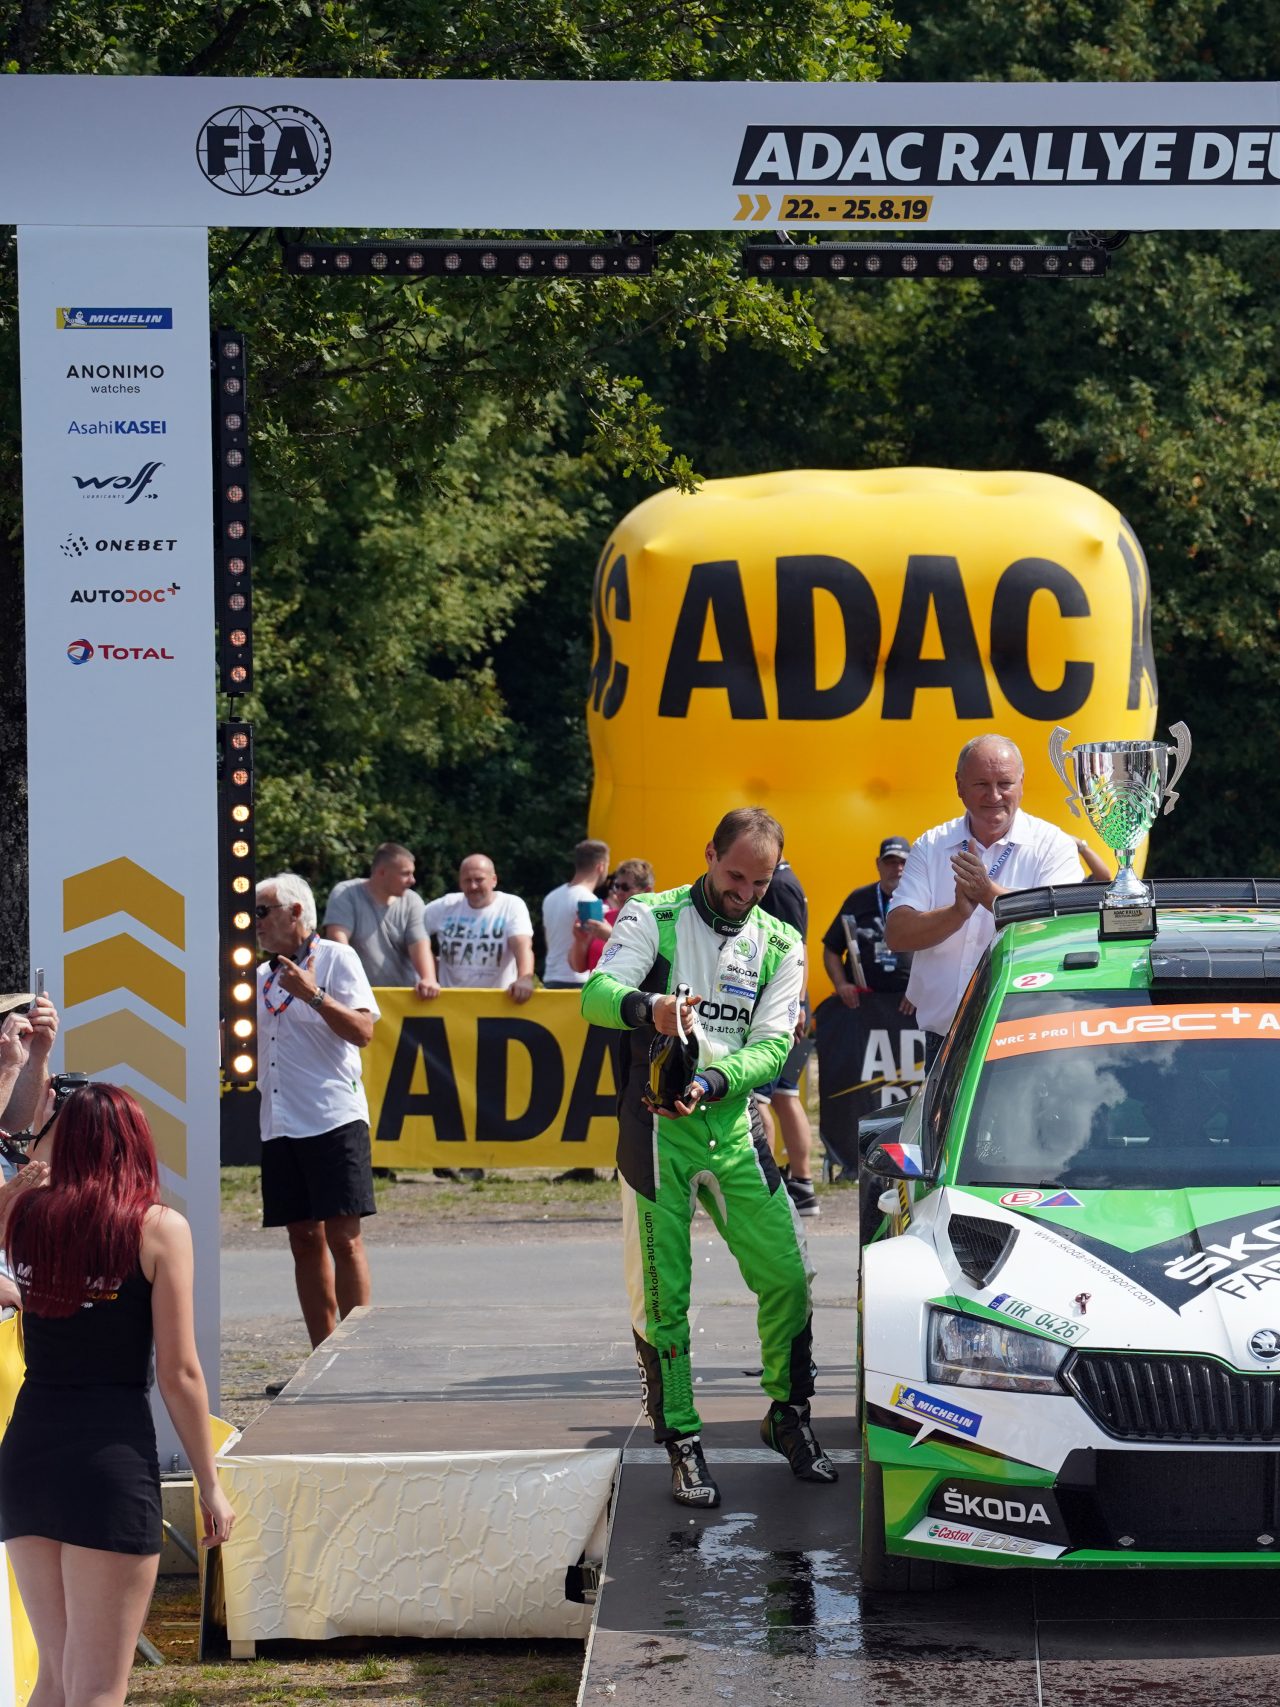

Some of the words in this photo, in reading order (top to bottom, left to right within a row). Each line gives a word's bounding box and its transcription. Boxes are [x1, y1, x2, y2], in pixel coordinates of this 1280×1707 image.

[744, 131, 925, 182] ADAC
[937, 131, 1178, 182] RALLYE
[785, 199, 820, 219] 22.
[842, 199, 928, 220] 25.8.19
[88, 314, 163, 323] MICHELIN
[66, 364, 165, 379] ANONIMO
[91, 384, 141, 394] watches
[95, 539, 178, 551] ONEBET
[70, 589, 166, 603] AUTODOC
[658, 554, 1096, 721] ADAC
[769, 936, 790, 951] OMP
[699, 1000, 751, 1025] ODA
[995, 1034, 1024, 1047] WRC
[1029, 1031, 1037, 1041] 2
[1041, 1027, 1069, 1038] PRO
[1034, 1229, 1157, 1308] www.skoda-motorsport.com
[1004, 1300, 1033, 1318] 11R
[1035, 1313, 1079, 1339] 0426
[917, 1399, 973, 1429] MICHELIN
[943, 1487, 1052, 1526] ŠKODA
[937, 1526, 973, 1543] Castrol
[971, 1531, 1045, 1556] EDGE
